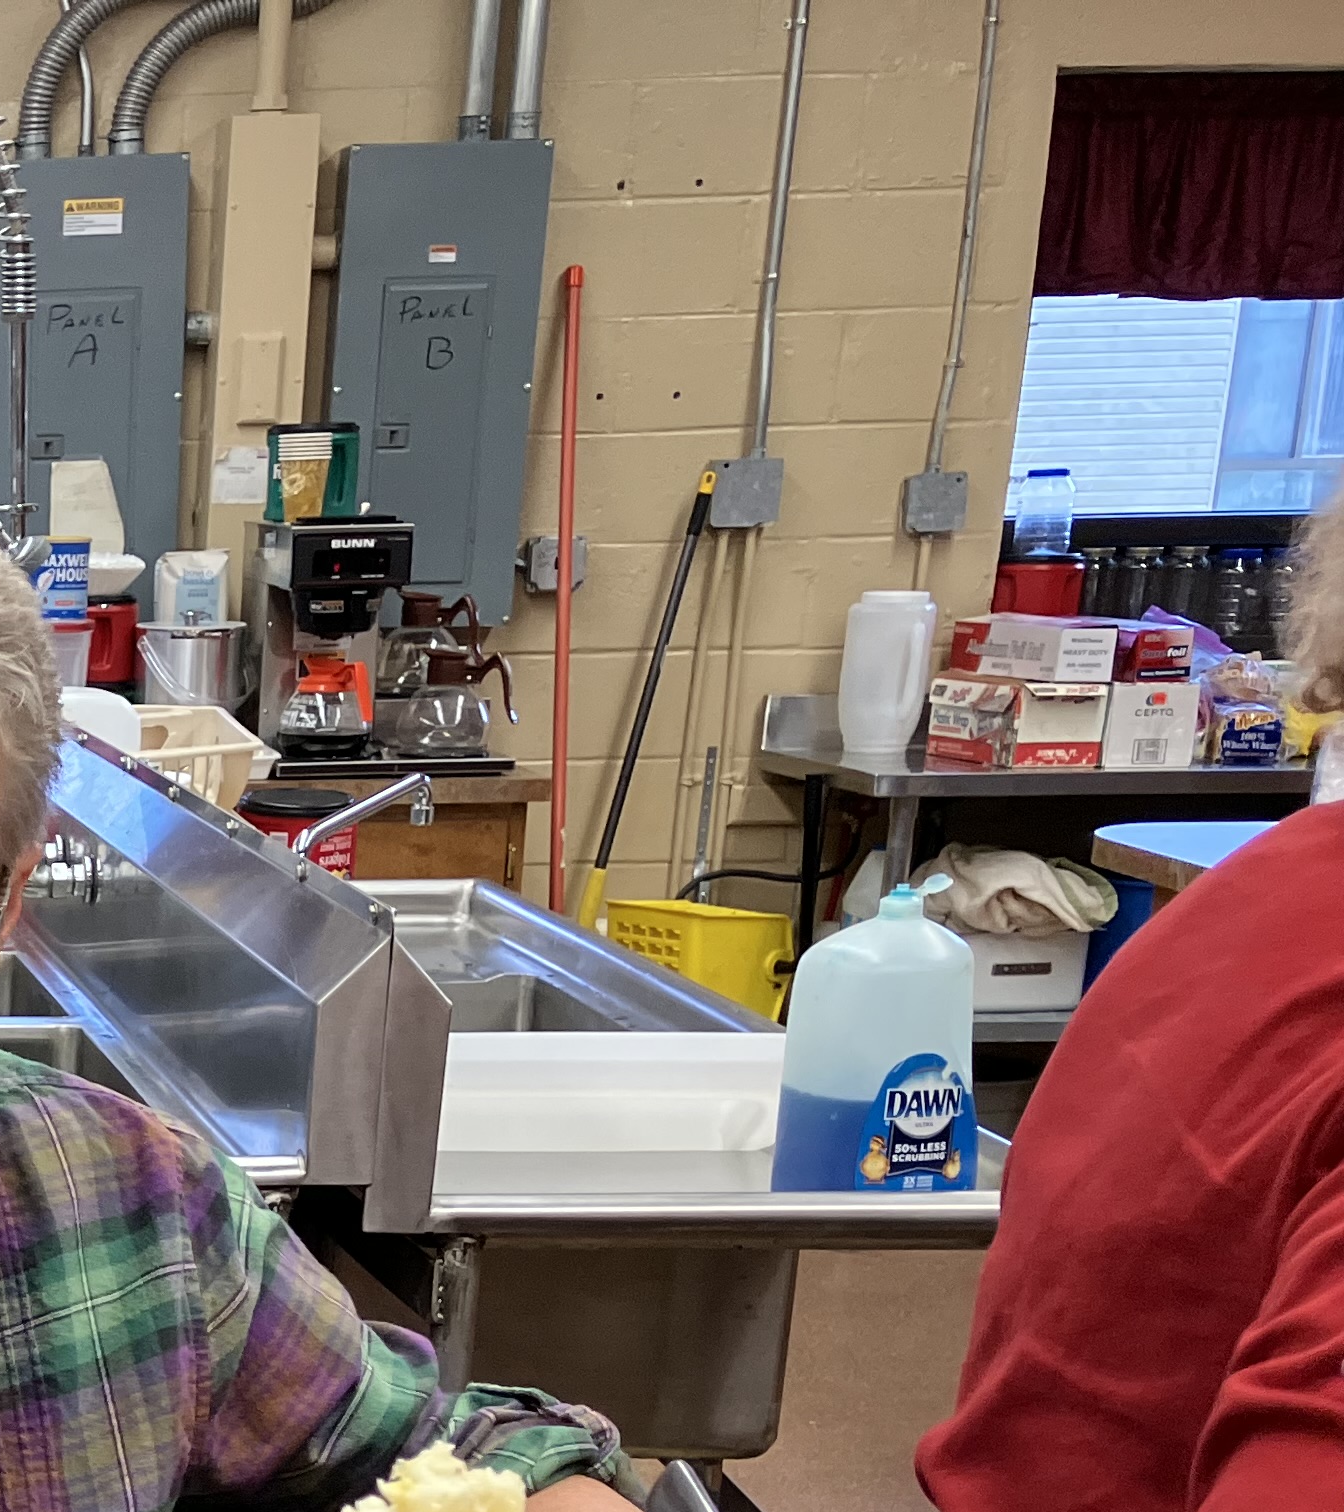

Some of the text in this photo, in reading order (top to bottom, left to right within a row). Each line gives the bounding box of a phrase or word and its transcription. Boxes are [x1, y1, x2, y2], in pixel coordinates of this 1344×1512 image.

[68, 333, 98, 368] A
[426, 336, 453, 370] B
[330, 538, 375, 549] BUNN
[41, 553, 88, 568] AXWE
[55, 567, 88, 582] HOUS
[885, 1087, 962, 1120] DAWN
[894, 1141, 947, 1154] 50% LESS
[892, 1152, 946, 1163] SCRUBBING
